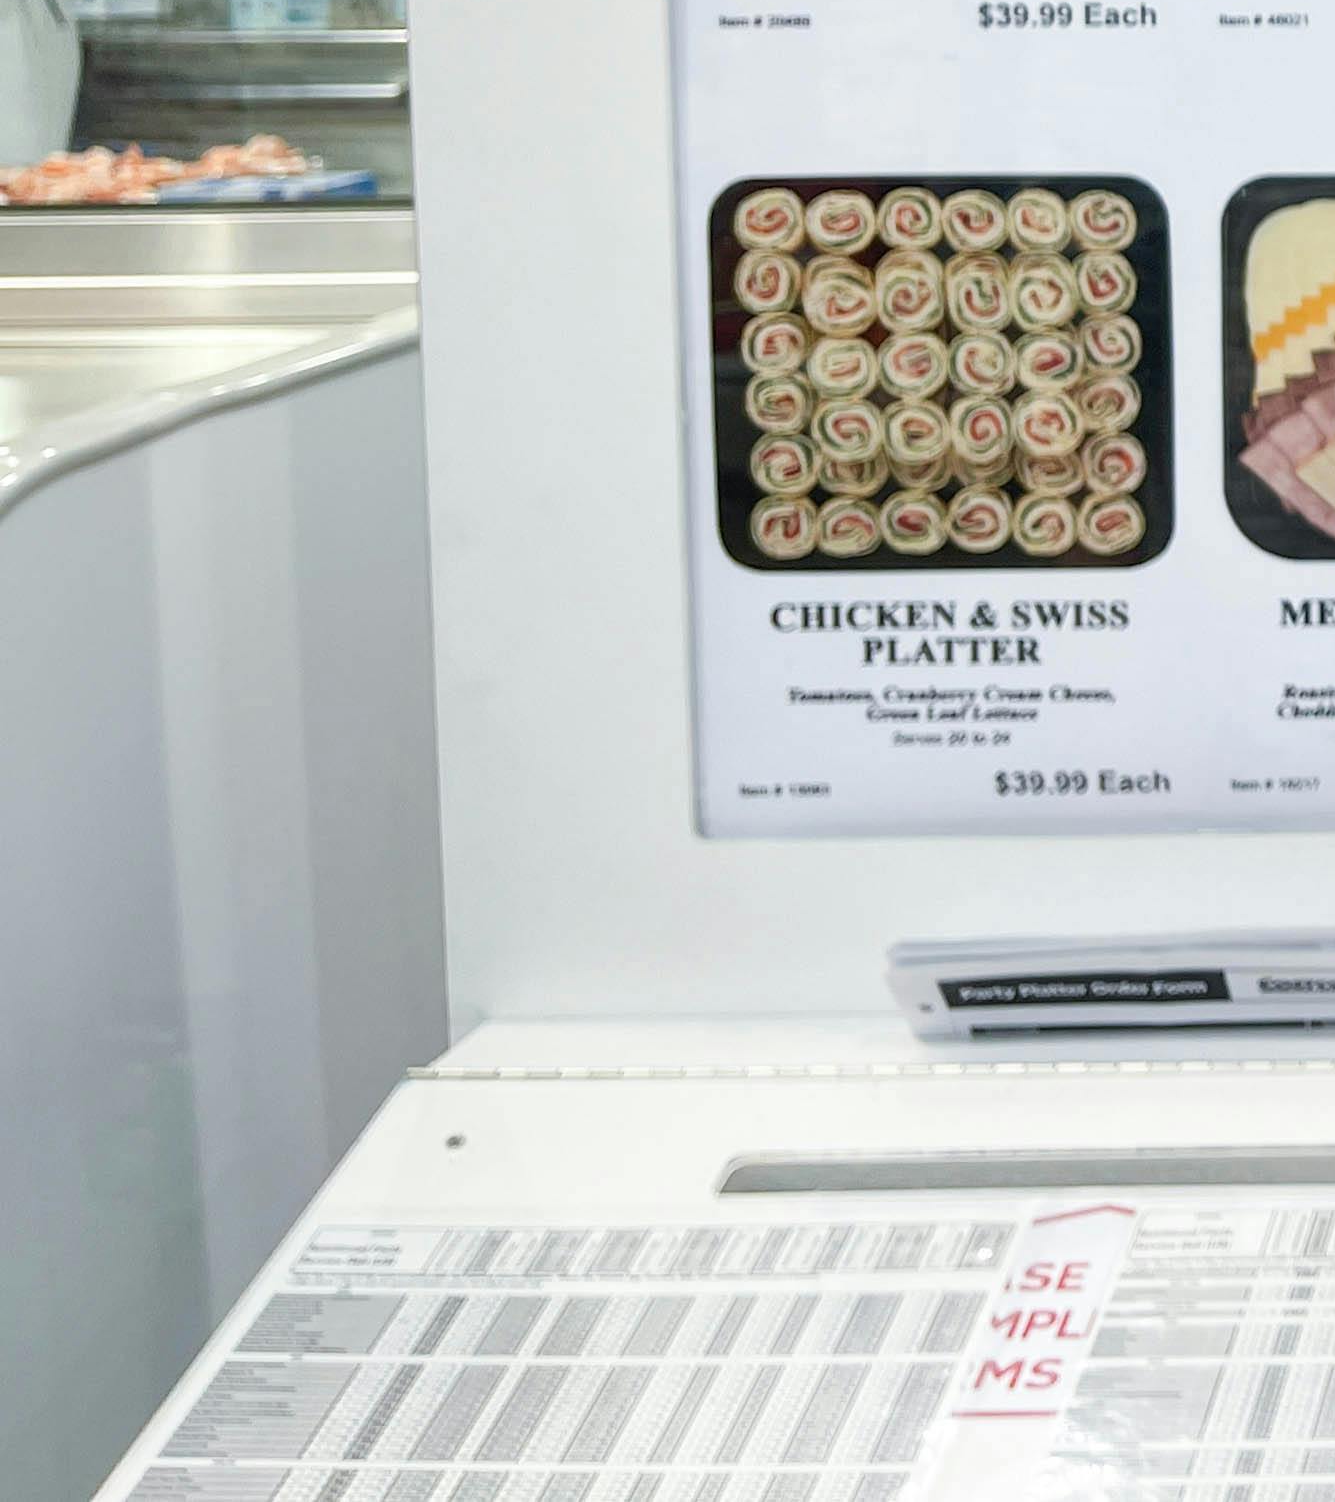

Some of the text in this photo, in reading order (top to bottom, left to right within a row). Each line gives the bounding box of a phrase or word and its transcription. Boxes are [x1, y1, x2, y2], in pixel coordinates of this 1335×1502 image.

[978, 2, 1157, 28] $39.99 Each
[770, 601, 1130, 631] CHICKEN & SWISS
[862, 637, 1041, 665] PLATTER
[994, 769, 1171, 797] $39.99 Each
